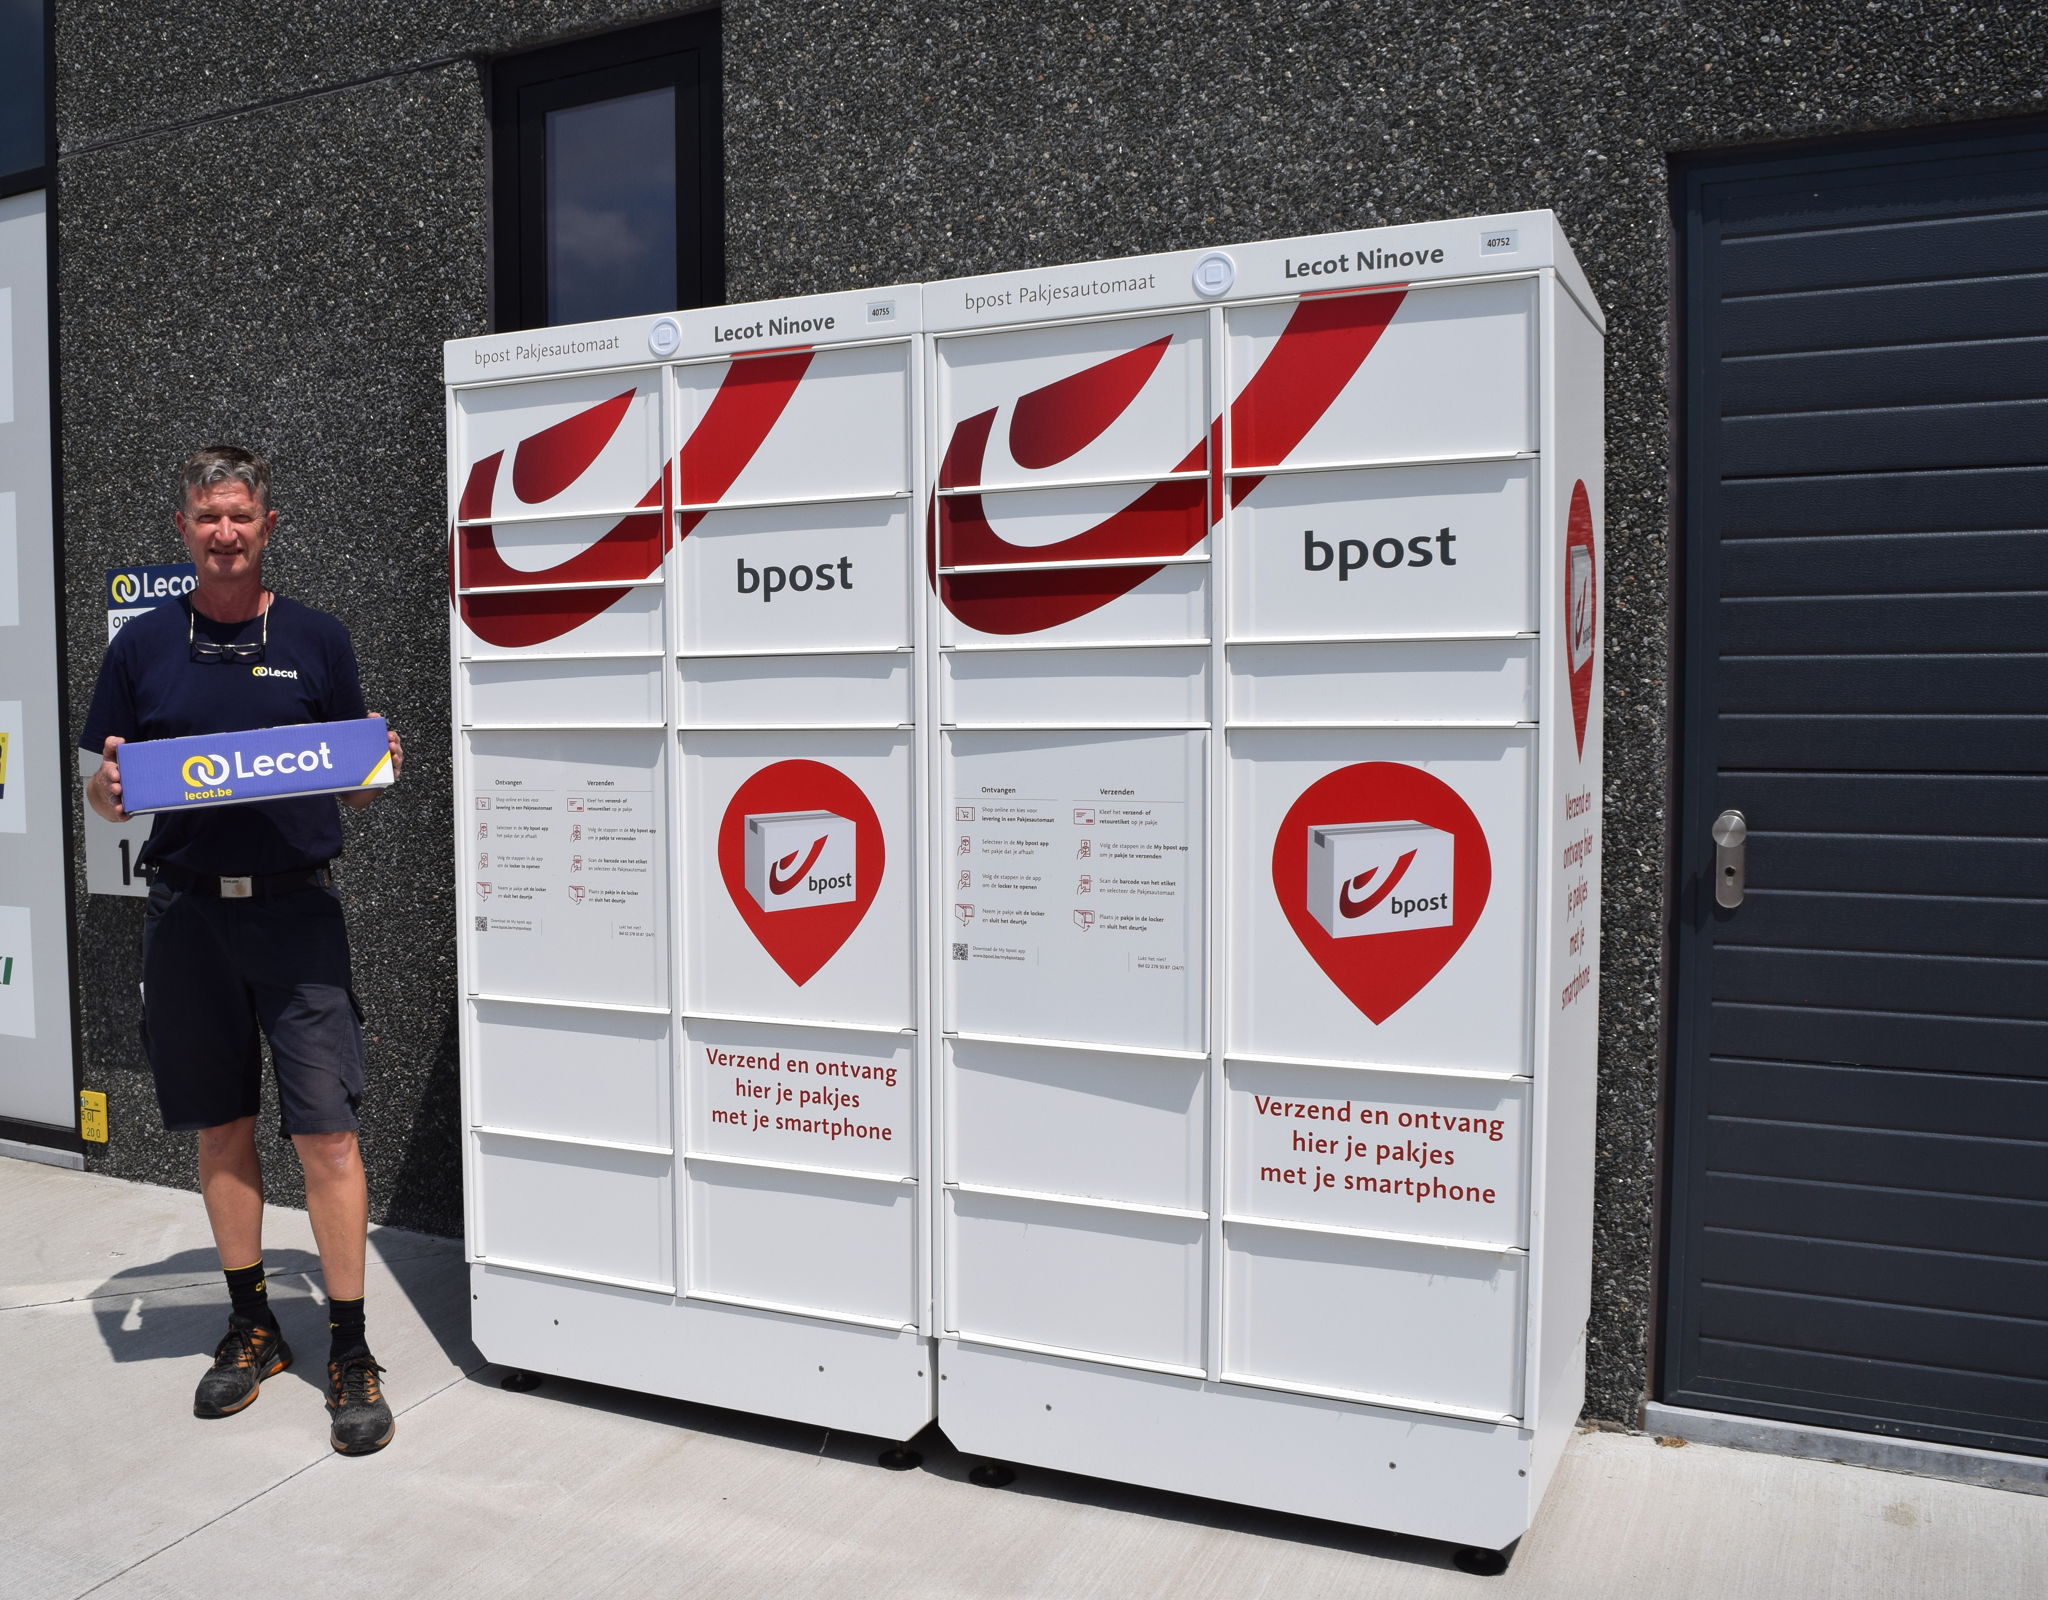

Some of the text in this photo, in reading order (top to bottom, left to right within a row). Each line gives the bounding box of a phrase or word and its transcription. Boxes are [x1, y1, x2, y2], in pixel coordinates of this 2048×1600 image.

[1486, 237, 1510, 248] 40752
[1285, 248, 1444, 279] Lecot Ninove
[964, 273, 1156, 314] bpost Pakjesautomaat
[872, 307, 890, 317] 40755
[714, 316, 835, 343] Lecot Ninove
[475, 335, 620, 368] bpost Pakjesautomaat
[1304, 527, 1456, 581] bpost
[143, 572, 199, 598] Leco
[737, 556, 853, 602] bpost
[268, 666, 298, 680] Lecot
[234, 741, 333, 779] Lecot
[184, 788, 233, 801] lecot.be
[982, 786, 1016, 795] Ontvangen
[808, 872, 852, 894] bpost
[1391, 892, 1448, 918] bpost
[706, 1048, 897, 1086] Verzend en ontvang
[736, 1078, 860, 1111] hier je pakjes
[712, 1109, 892, 1140] met je smartphone
[1254, 1095, 1504, 1142] Verzend en ontvang
[1293, 1130, 1455, 1169] hier je pakjes
[1260, 1166, 1496, 1204] met je smartphone
